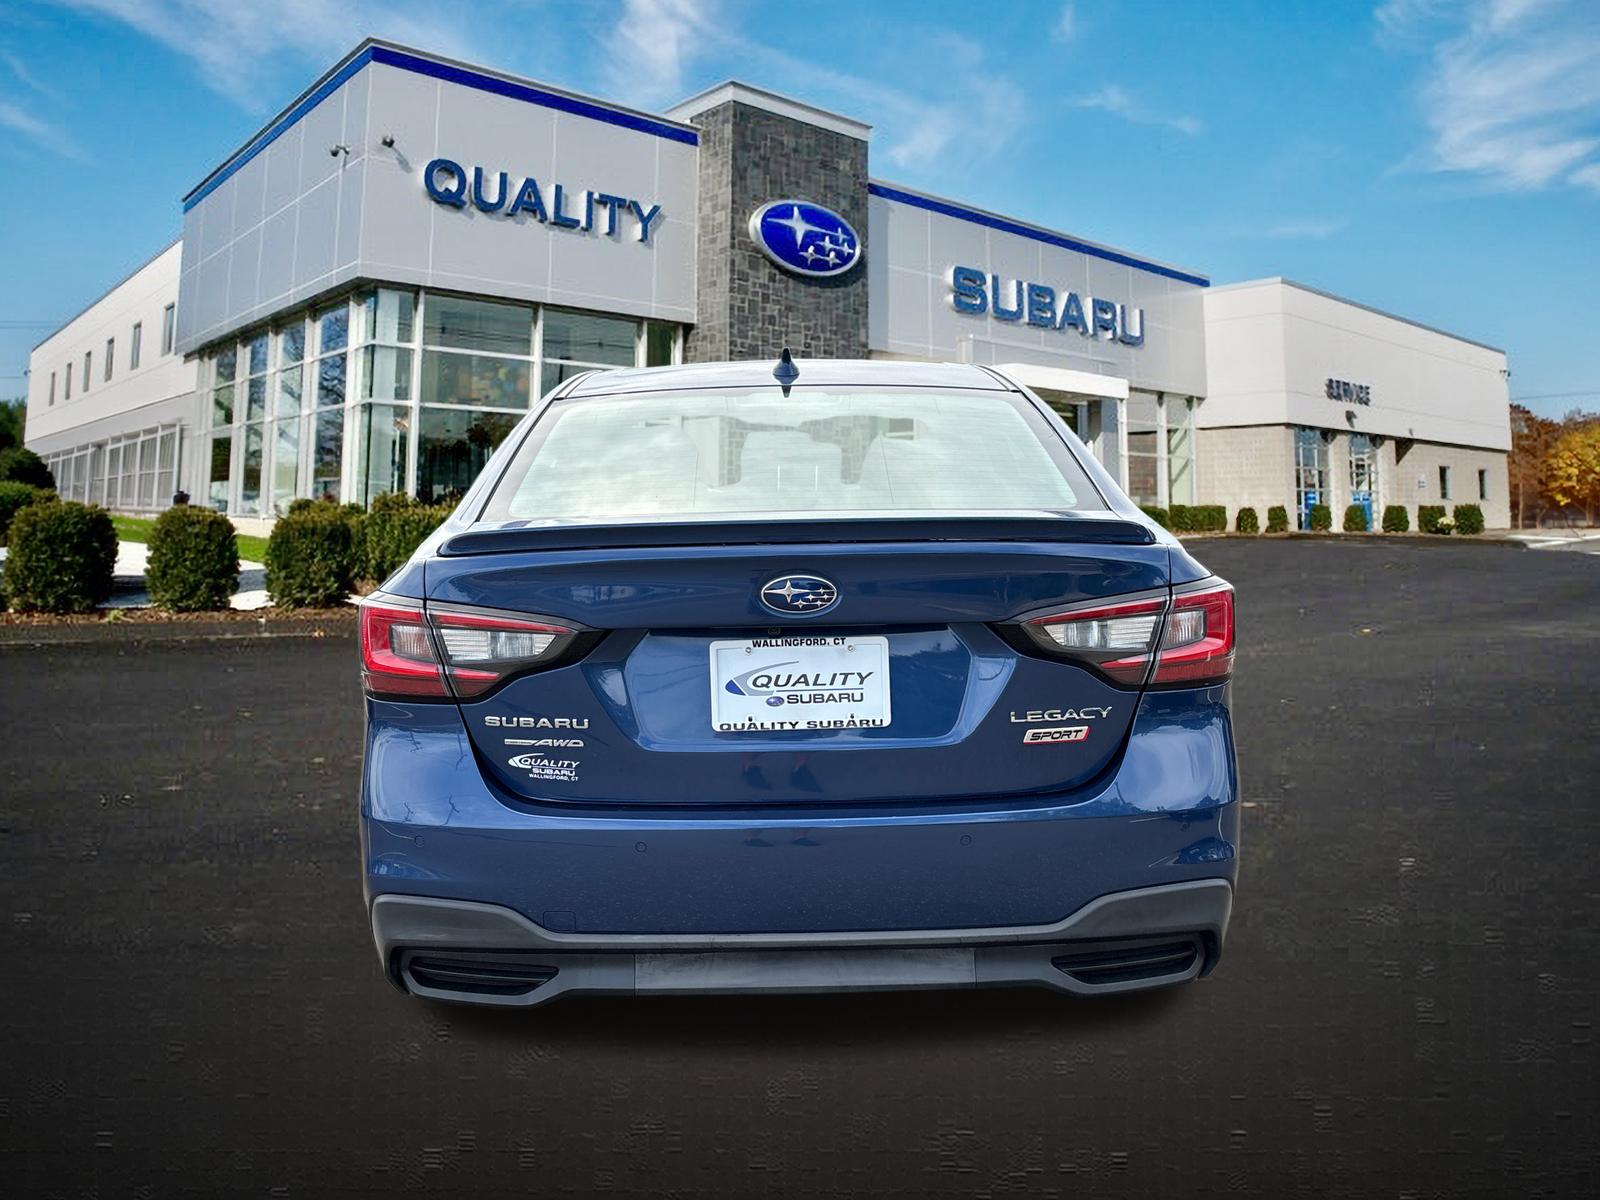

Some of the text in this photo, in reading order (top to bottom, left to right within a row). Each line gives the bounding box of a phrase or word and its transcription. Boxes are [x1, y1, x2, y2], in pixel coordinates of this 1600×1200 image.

[424, 158, 661, 242] QUALITY
[948, 265, 1145, 346] SUBARU
[833, 637, 846, 646] CT
[752, 671, 874, 689] QUALITY
[786, 692, 864, 704] SUBARU
[1010, 706, 1113, 723] LEGACY
[484, 716, 589, 729] SUBARU
[719, 718, 883, 731] QUALITY SUBARU
[1030, 729, 1083, 741] SPORT
[534, 739, 585, 748] AWD
[520, 757, 580, 768] QUALITY
[532, 768, 576, 776] SUBARU
